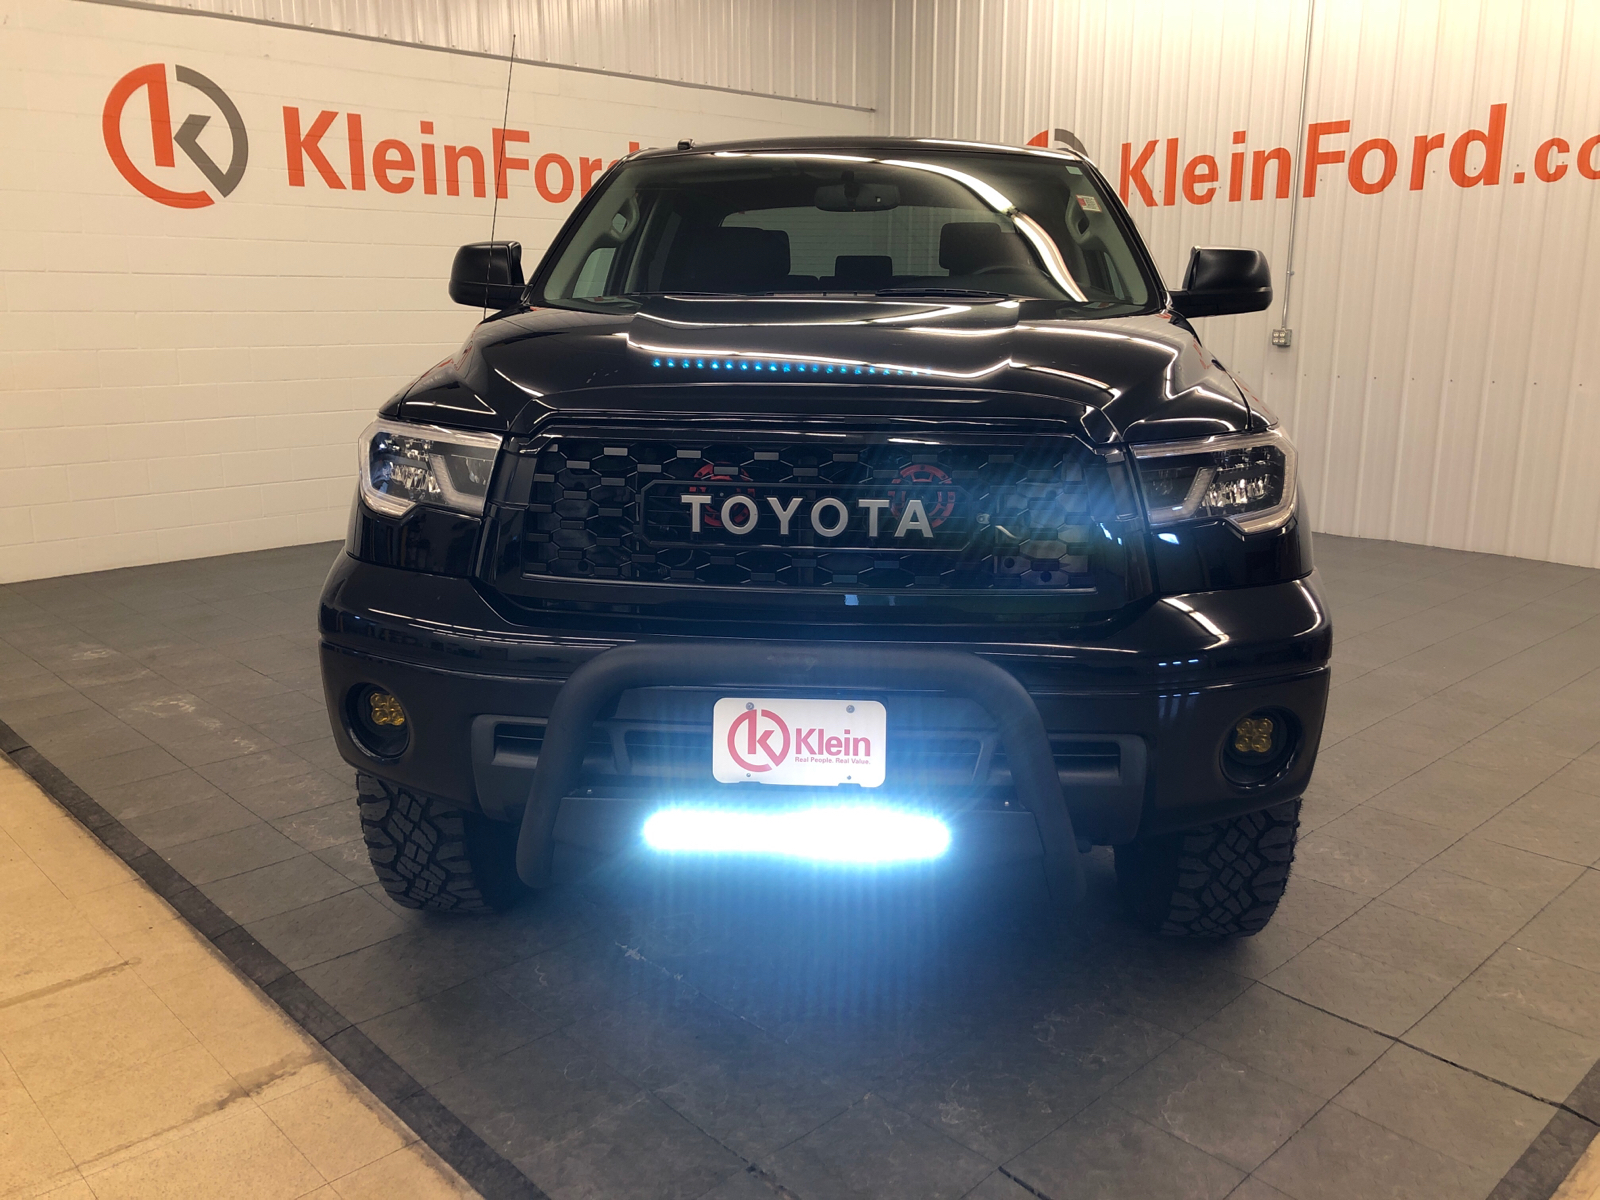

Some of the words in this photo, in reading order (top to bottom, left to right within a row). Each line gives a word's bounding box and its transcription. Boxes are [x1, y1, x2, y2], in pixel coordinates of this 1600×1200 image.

[281, 105, 640, 204] KleinFor
[681, 495, 934, 538] TOYOTA
[795, 728, 871, 757] Klein
